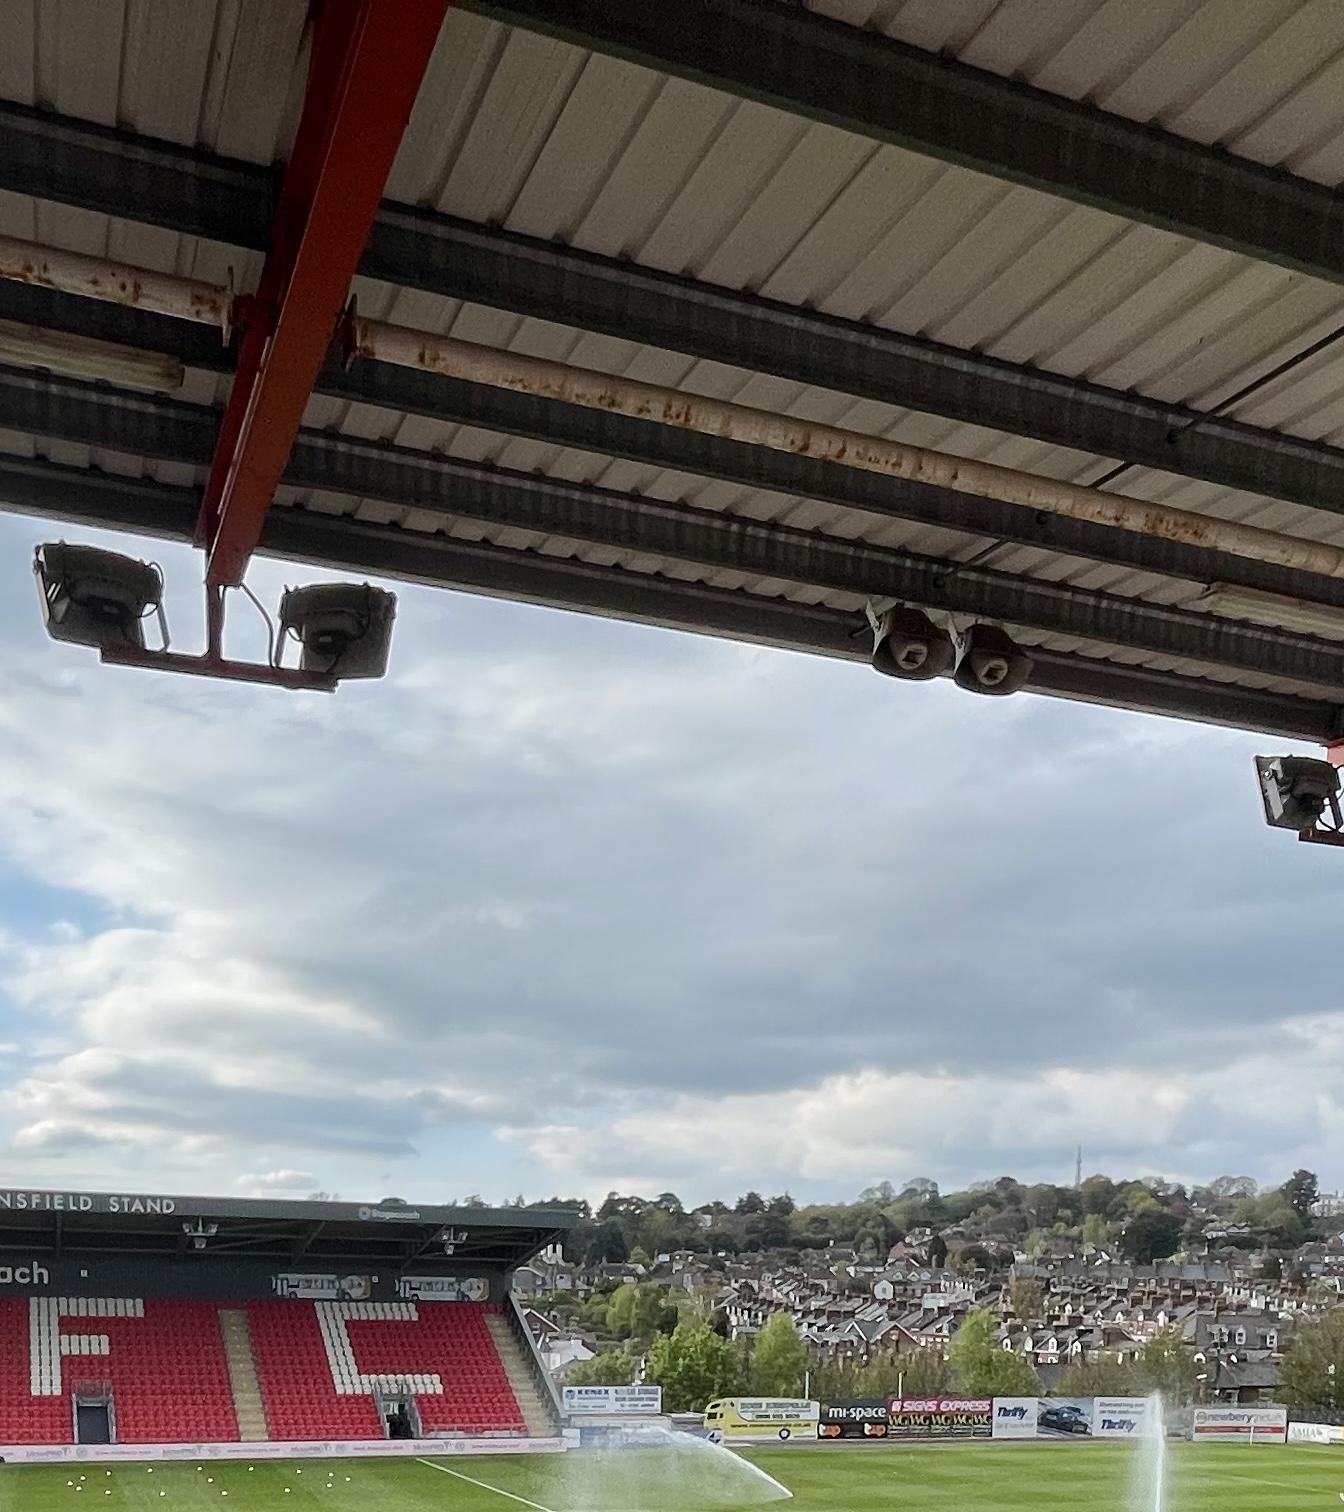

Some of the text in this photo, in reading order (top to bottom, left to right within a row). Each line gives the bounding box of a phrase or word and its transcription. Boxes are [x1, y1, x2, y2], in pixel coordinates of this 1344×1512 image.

[108, 1196, 176, 1215] STAND
[29, 1296, 145, 1396] F
[902, 1400, 991, 1412] SIGNS EXPRESS
